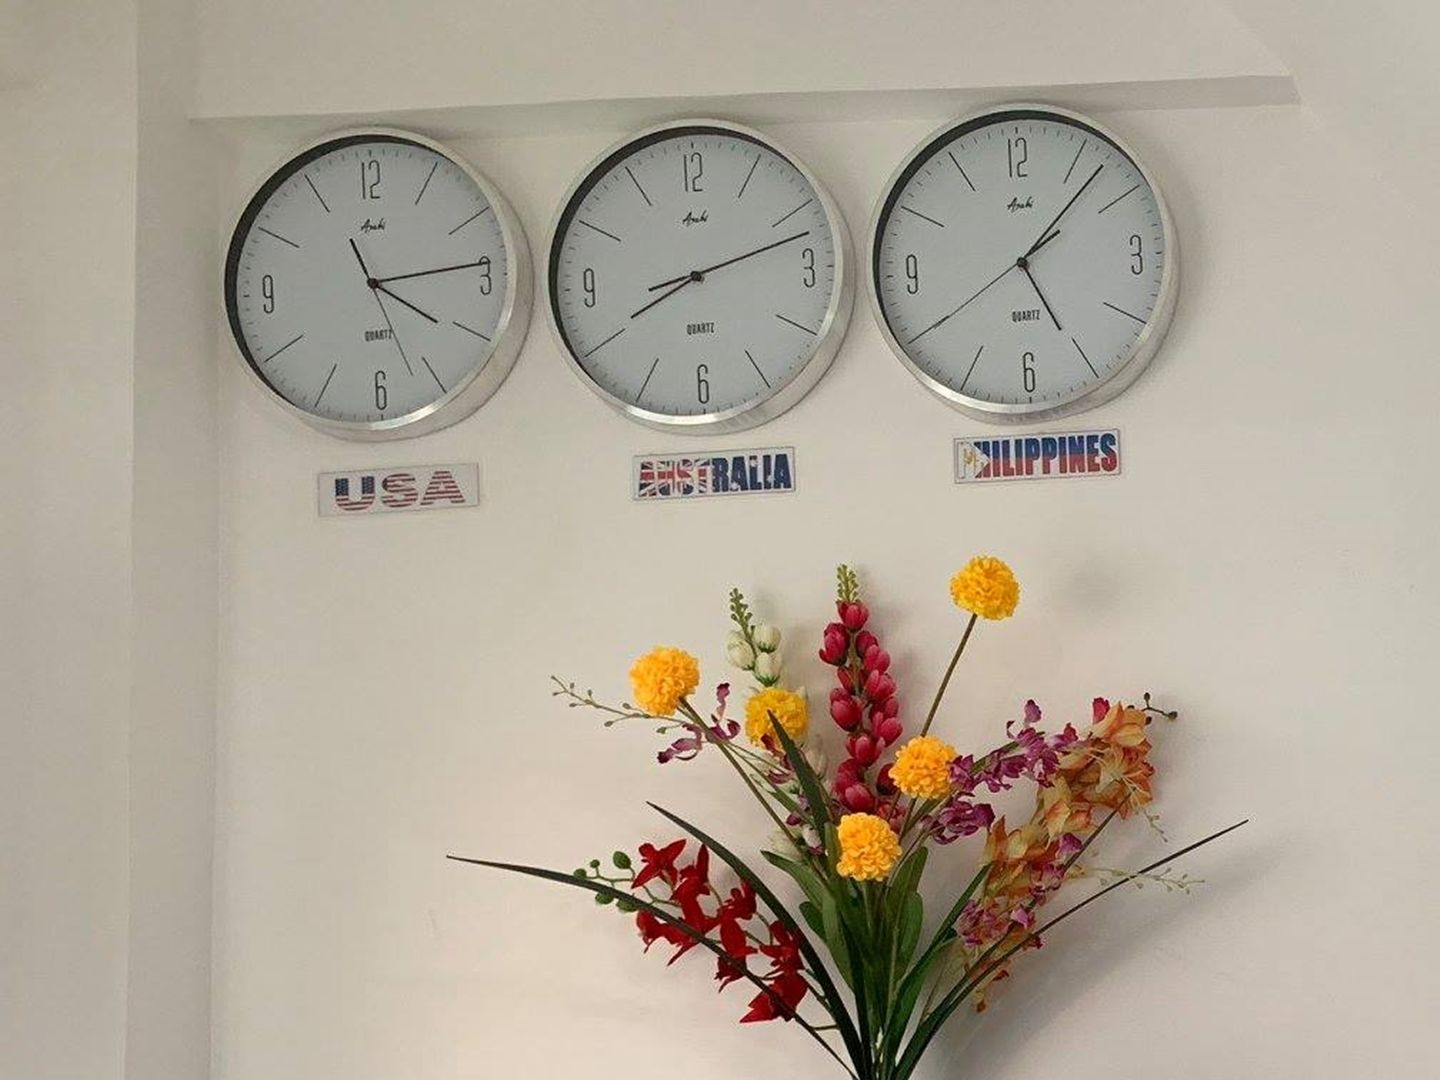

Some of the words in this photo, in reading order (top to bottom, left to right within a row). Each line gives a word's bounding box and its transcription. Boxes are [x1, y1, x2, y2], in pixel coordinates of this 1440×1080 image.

[683, 151, 703, 192] 12
[1008, 136, 1028, 178] 12
[361, 158, 380, 200] 12
[802, 248, 815, 288] 3
[906, 254, 919, 294] 9
[1130, 234, 1143, 275] 3
[262, 275, 274, 314] 9
[480, 256, 492, 295] 3
[583, 268, 595, 308] 9
[687, 322, 714, 335] QUARTZ
[1012, 309, 1040, 323] QUARTZ
[375, 370, 387, 410] 6
[697, 364, 709, 404] 6
[1022, 352, 1037, 393] 6
[334, 470, 466, 511] USA
[638, 454, 792, 497] AUSTRALIA
